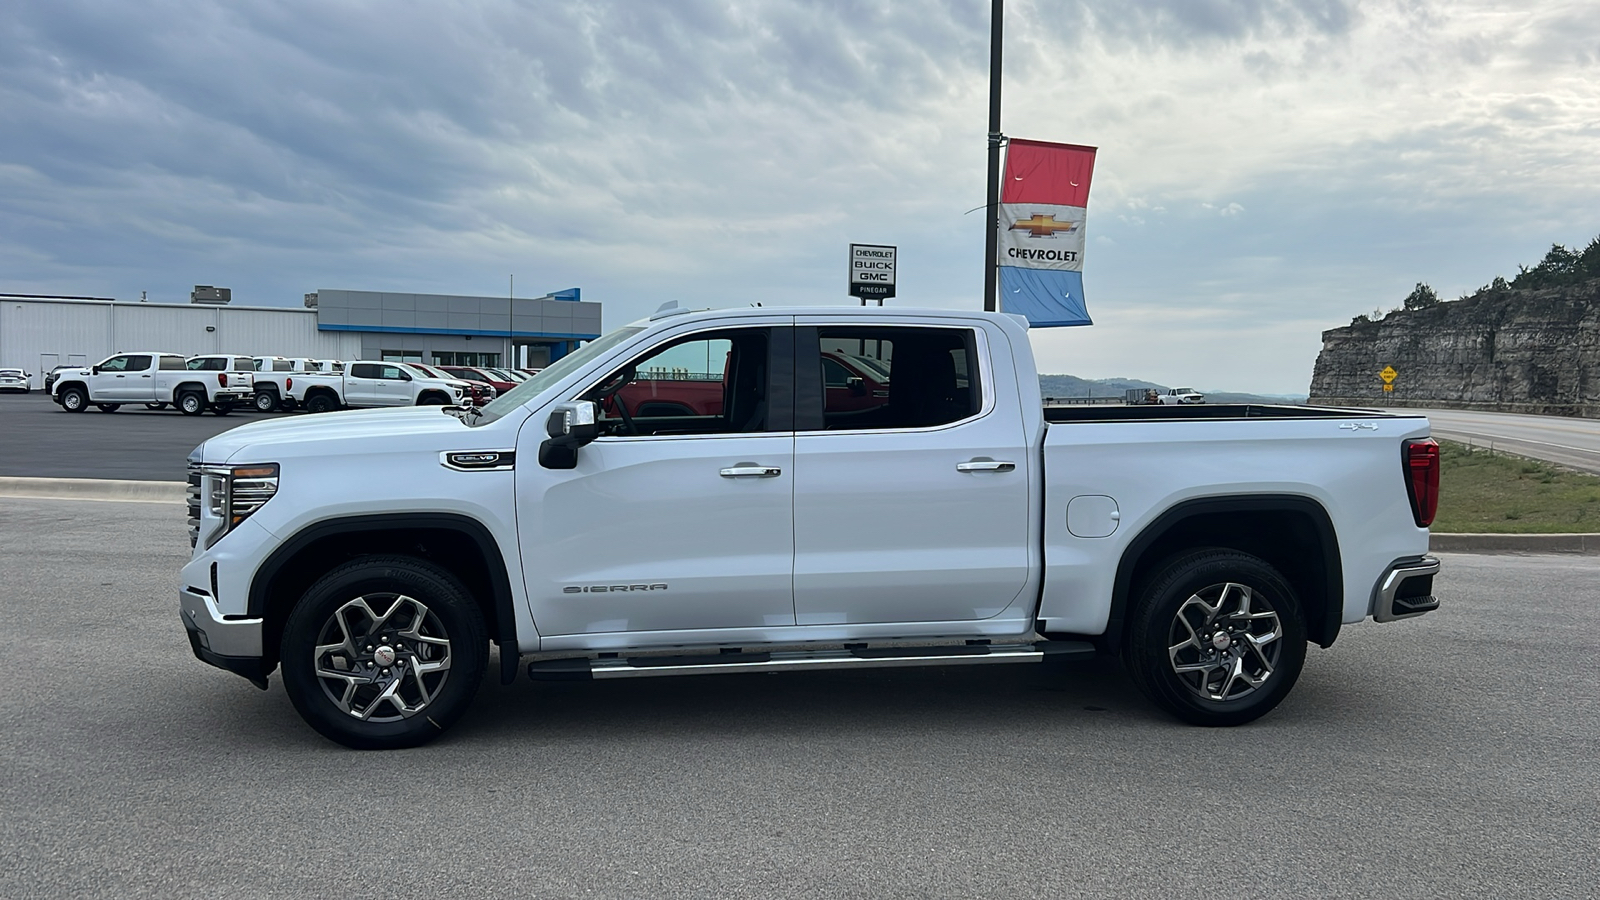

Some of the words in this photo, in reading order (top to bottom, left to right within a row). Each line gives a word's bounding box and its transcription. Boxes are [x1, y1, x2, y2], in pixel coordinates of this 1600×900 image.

[855, 249, 893, 258] CHEVROLET
[1008, 247, 1077, 262] CHEVROLET
[854, 261, 893, 270] BUICK
[860, 272, 888, 281] GMC
[860, 286, 888, 294] PINEGAR
[563, 582, 668, 594] SIERRA
